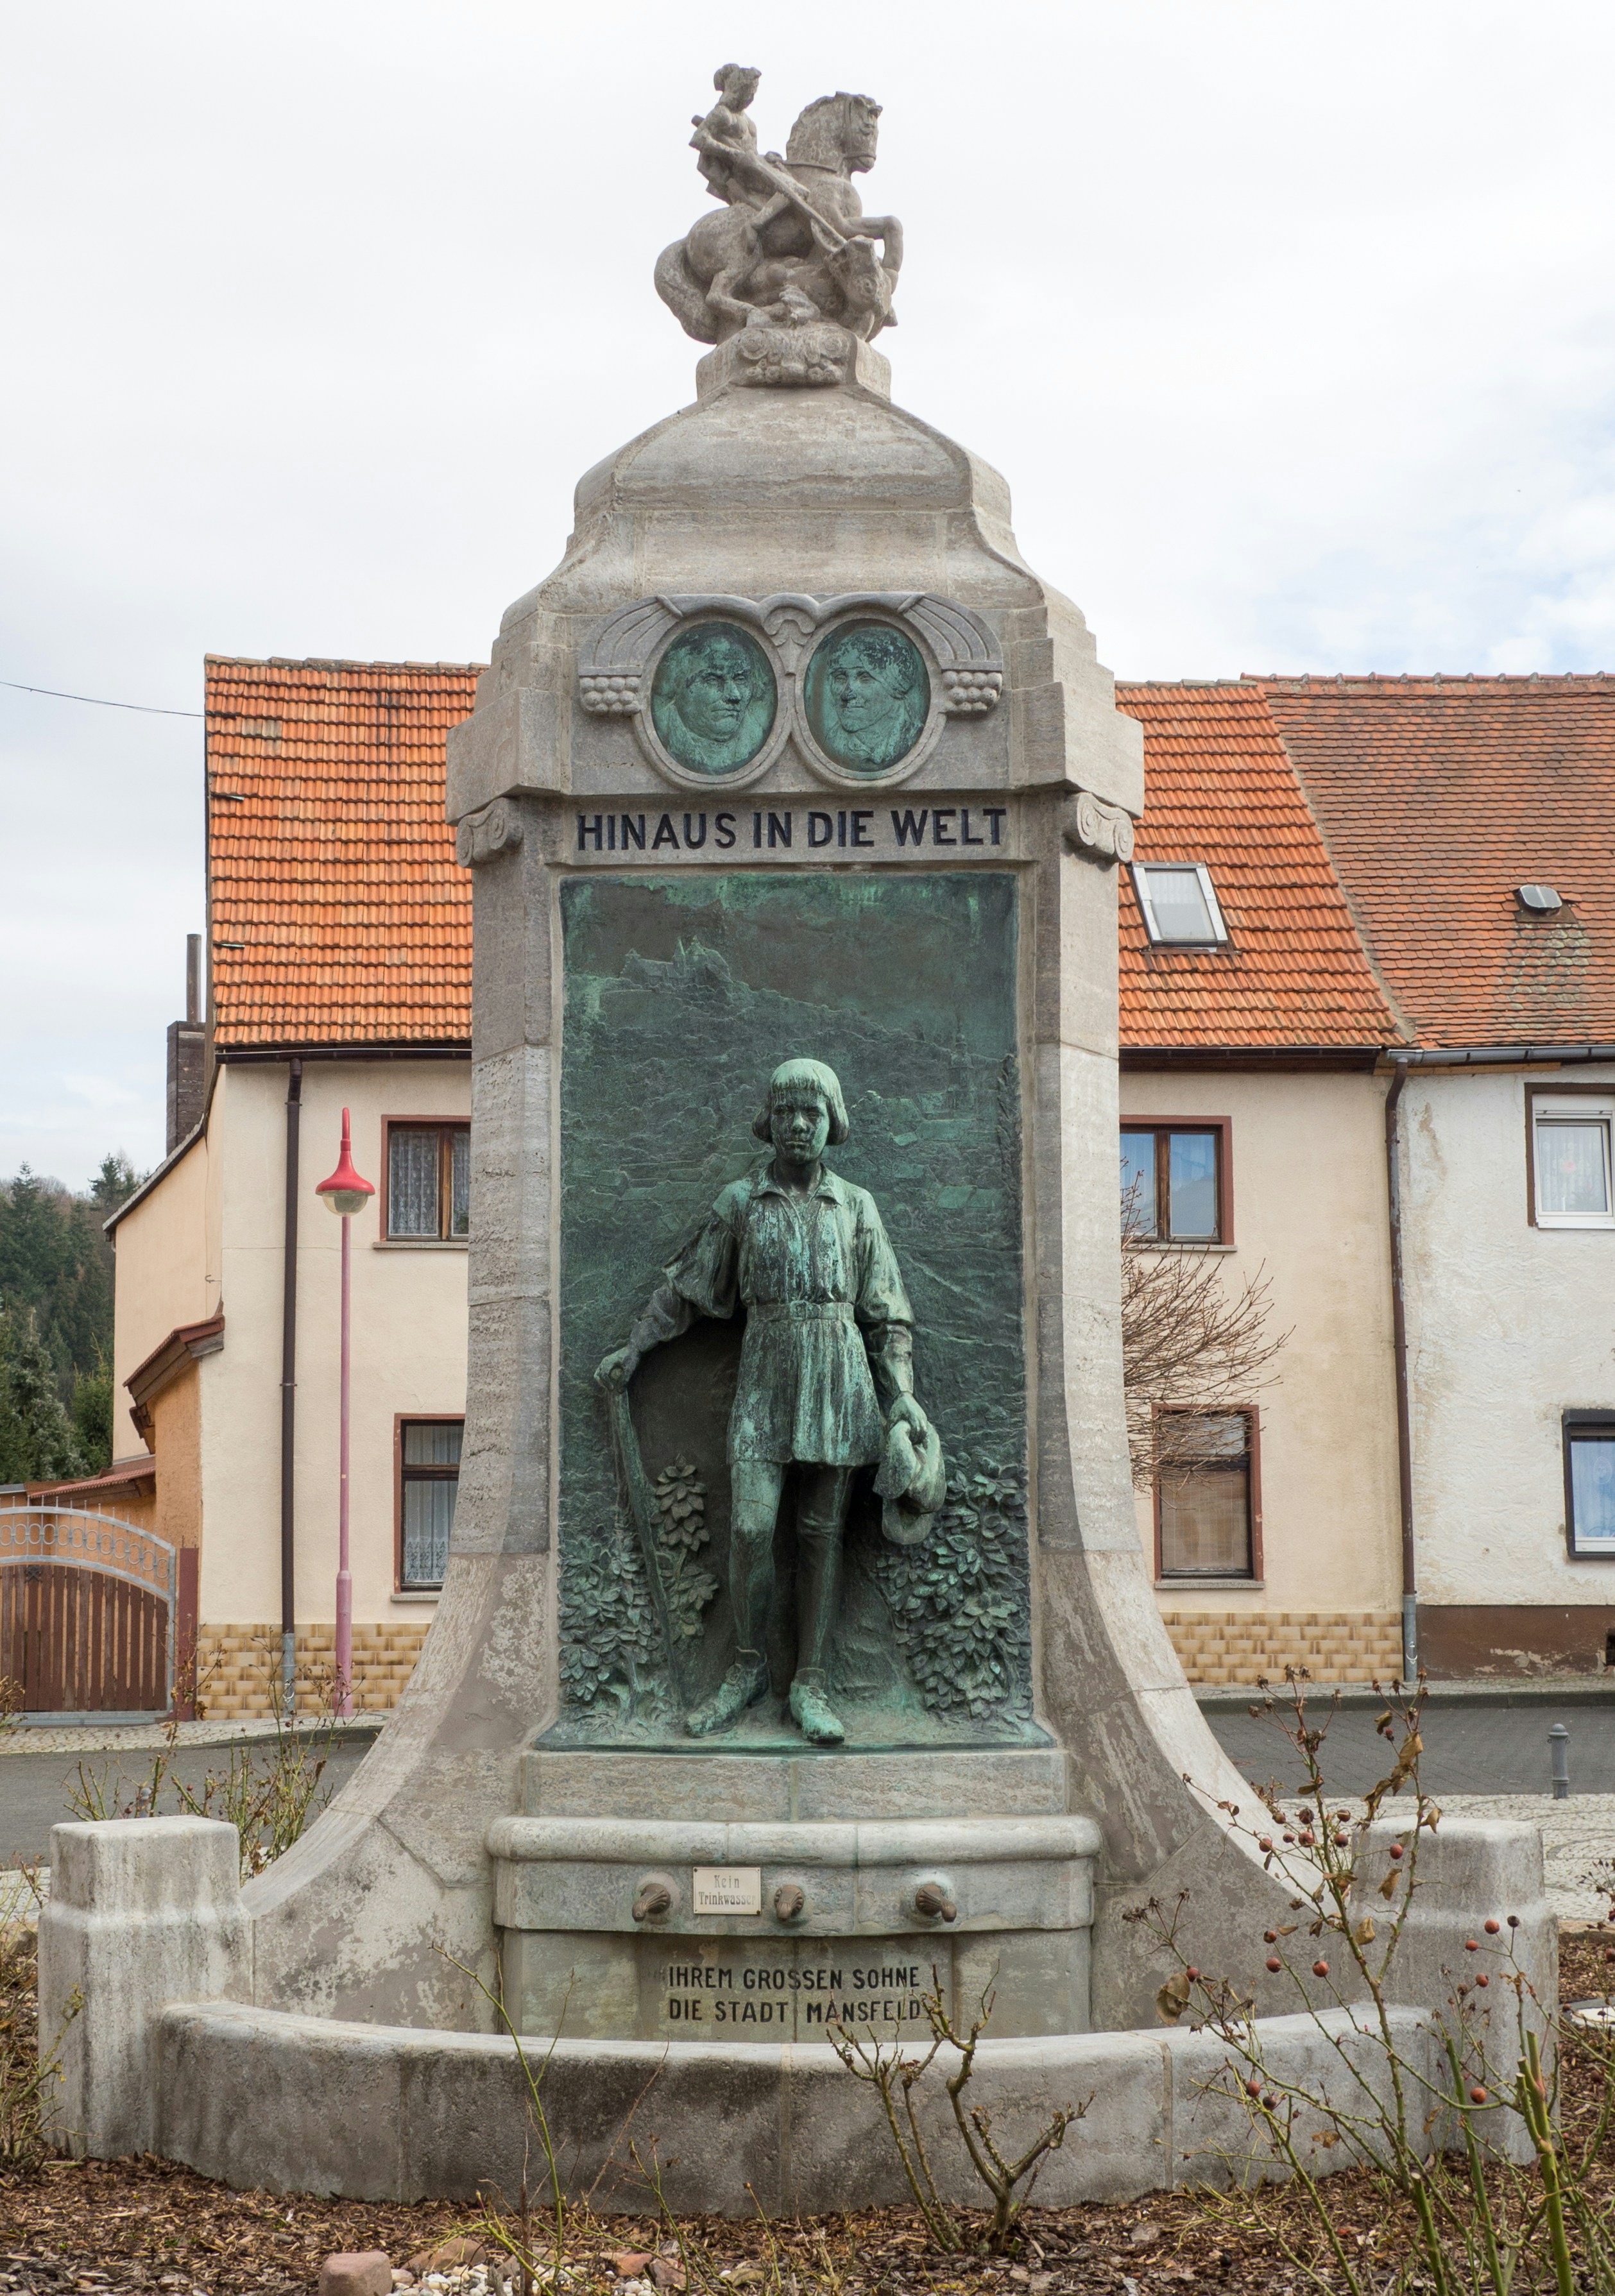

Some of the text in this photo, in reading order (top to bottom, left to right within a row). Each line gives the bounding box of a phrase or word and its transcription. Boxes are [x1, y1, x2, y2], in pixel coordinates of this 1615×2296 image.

[577, 808, 1007, 850] HINAUS IN DIE WELT
[714, 1875, 740, 1888] Kein
[698, 1891, 756, 1905] Trinkwasser
[669, 1966, 920, 1990] IHREM GROSSEN SOHNE
[669, 1998, 921, 2023] DIE STADT MANSFELD
